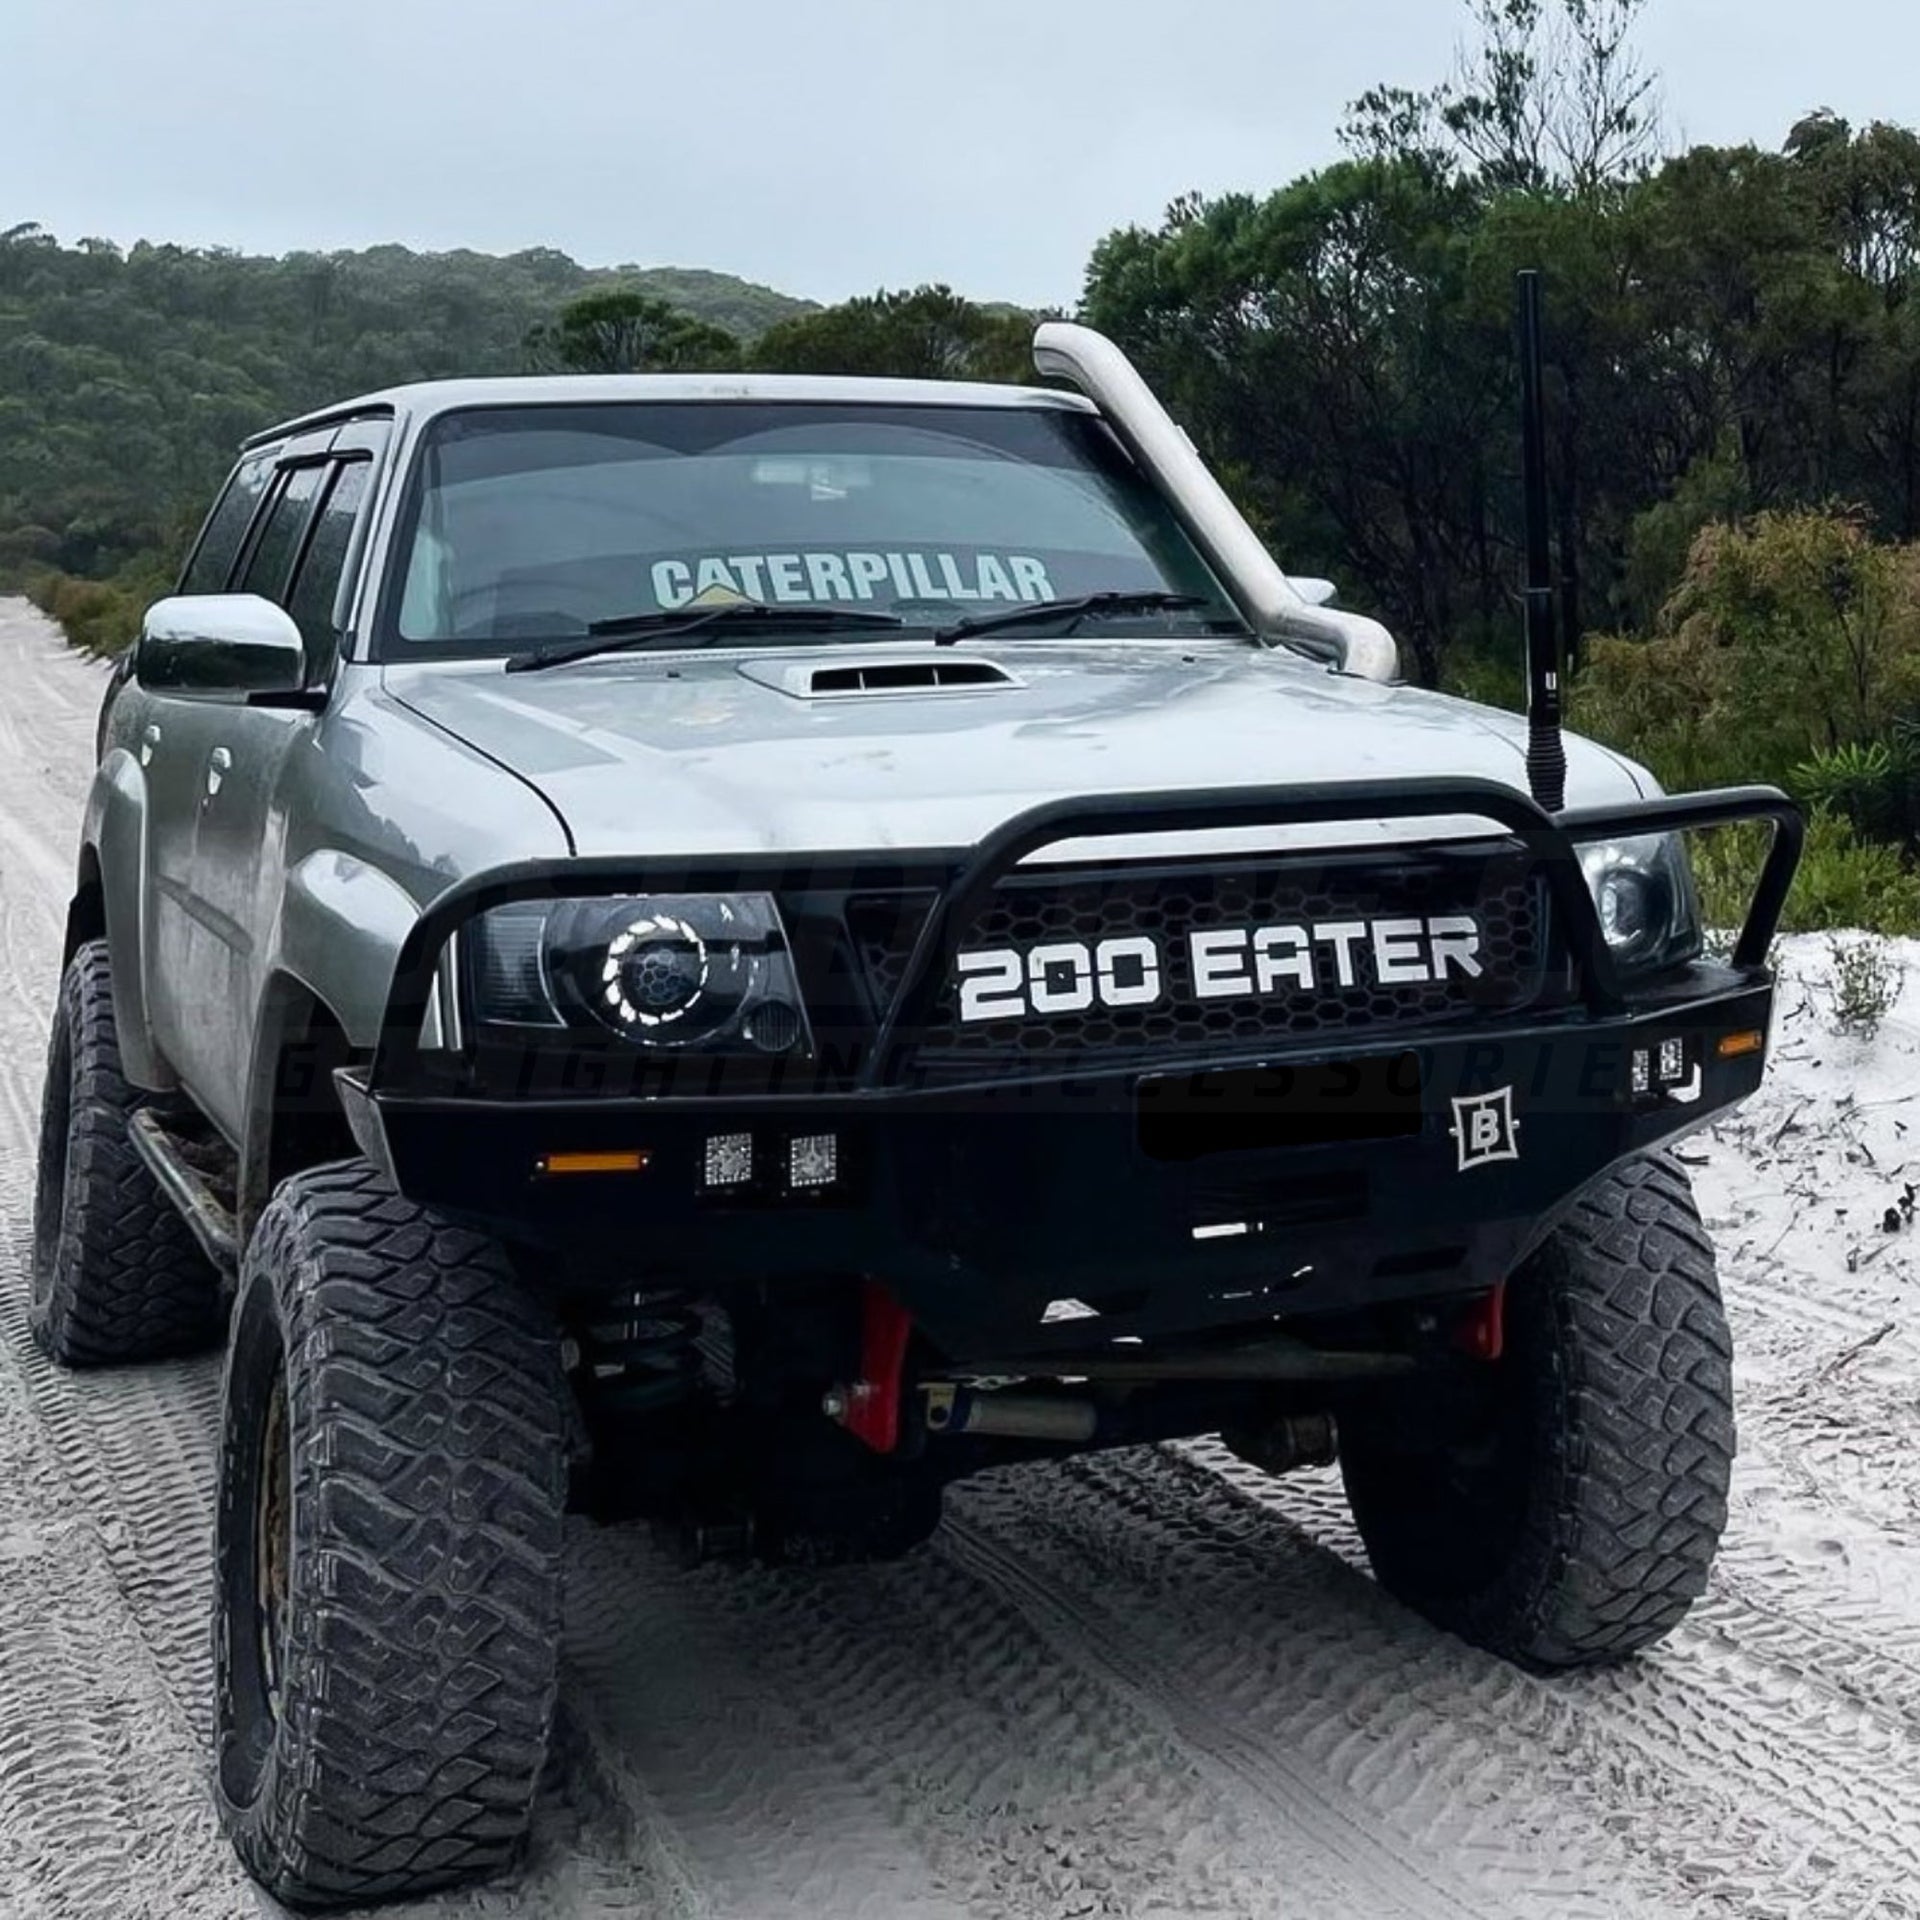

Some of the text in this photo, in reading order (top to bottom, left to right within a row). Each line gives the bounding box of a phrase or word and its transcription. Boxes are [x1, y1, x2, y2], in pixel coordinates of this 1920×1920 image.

[650, 553, 1056, 610] CATERPILLAR
[957, 936, 1160, 1021] 200
[1190, 916, 1484, 998] EATER
